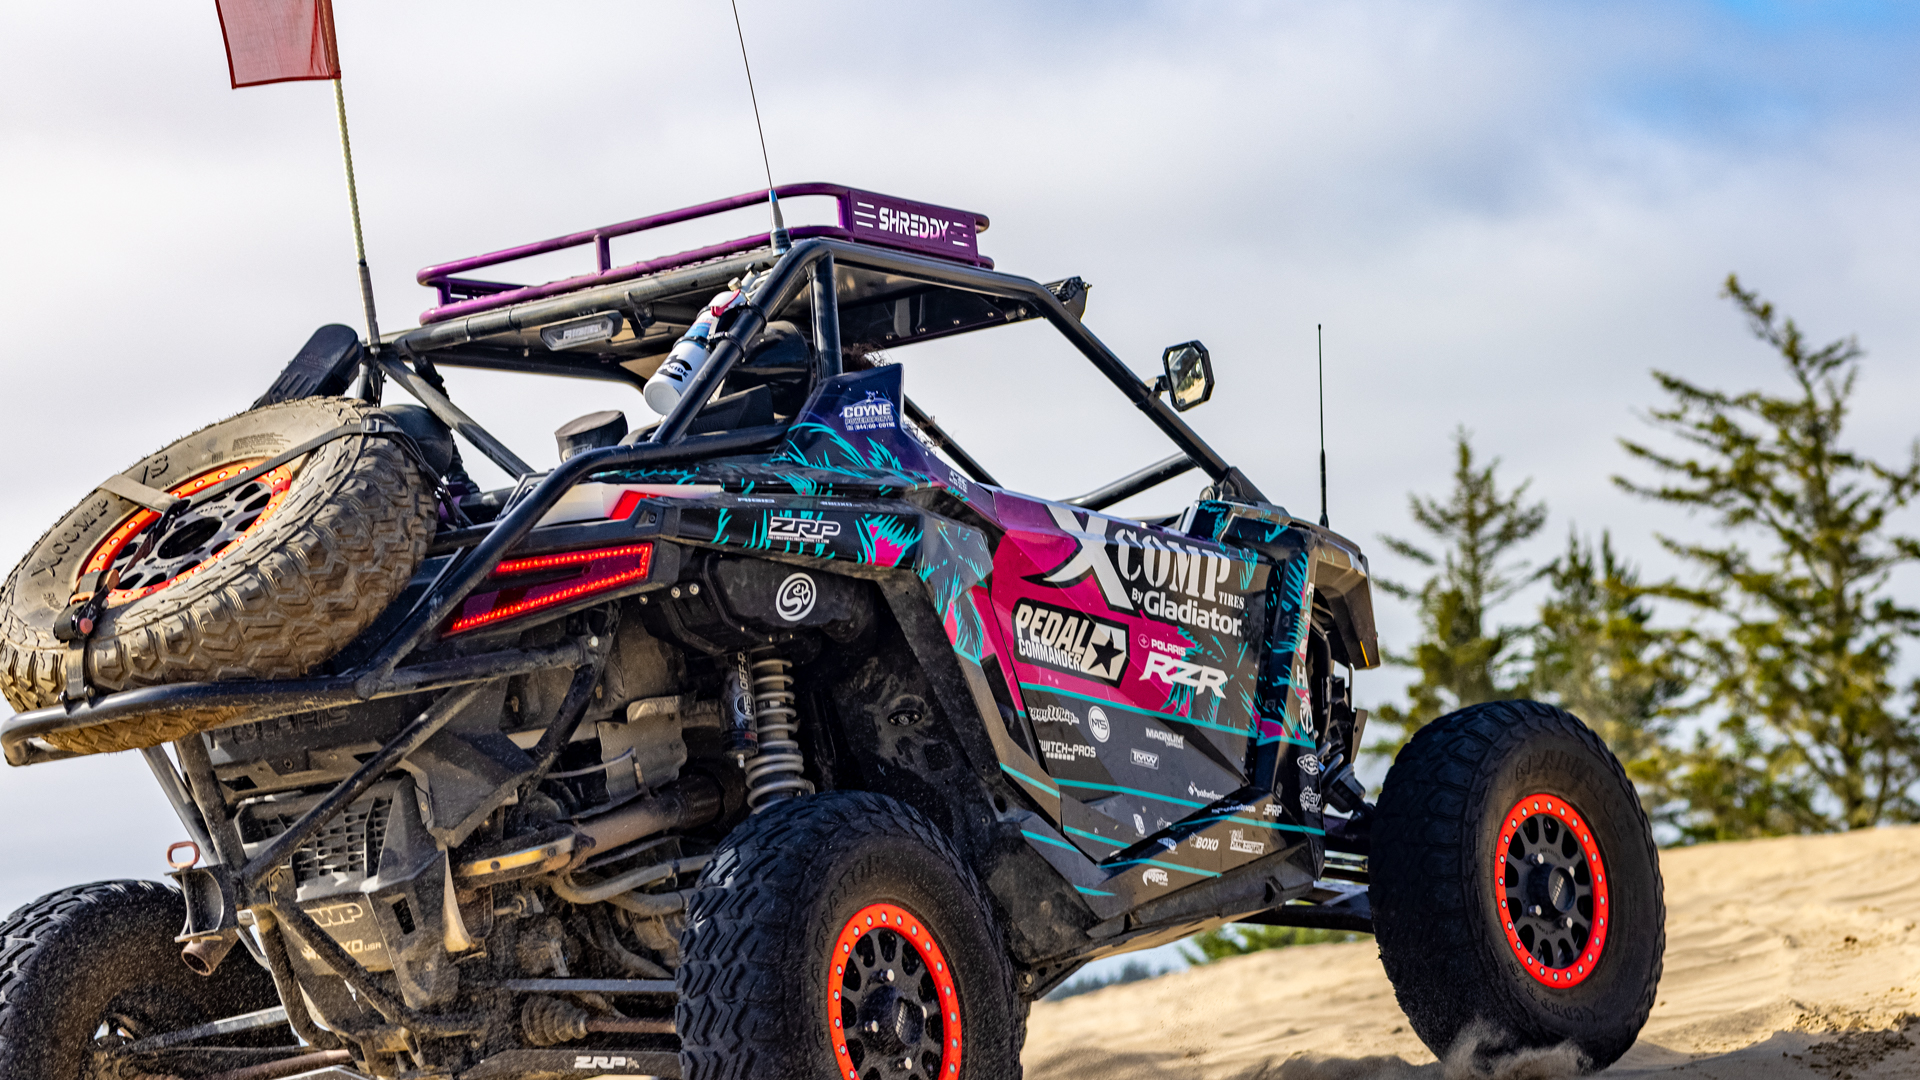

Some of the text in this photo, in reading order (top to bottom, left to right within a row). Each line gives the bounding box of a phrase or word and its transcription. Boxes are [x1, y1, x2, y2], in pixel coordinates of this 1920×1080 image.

[879, 207, 949, 242] SHREDDY
[843, 403, 891, 418] COYNE
[769, 516, 841, 539] ZRP
[1131, 587, 1144, 604] By
[1218, 590, 1245, 610] TIRES
[1015, 603, 1091, 655] PEDAL
[1018, 638, 1083, 672] COMMANDER
[1151, 638, 1186, 656] POLARIS
[1139, 651, 1229, 699] RZR
[1092, 718, 1108, 731] MTS
[1145, 727, 1185, 745] MAGNUM
[1195, 836, 1220, 851] BOXO
[574, 1055, 627, 1070] ZRP
